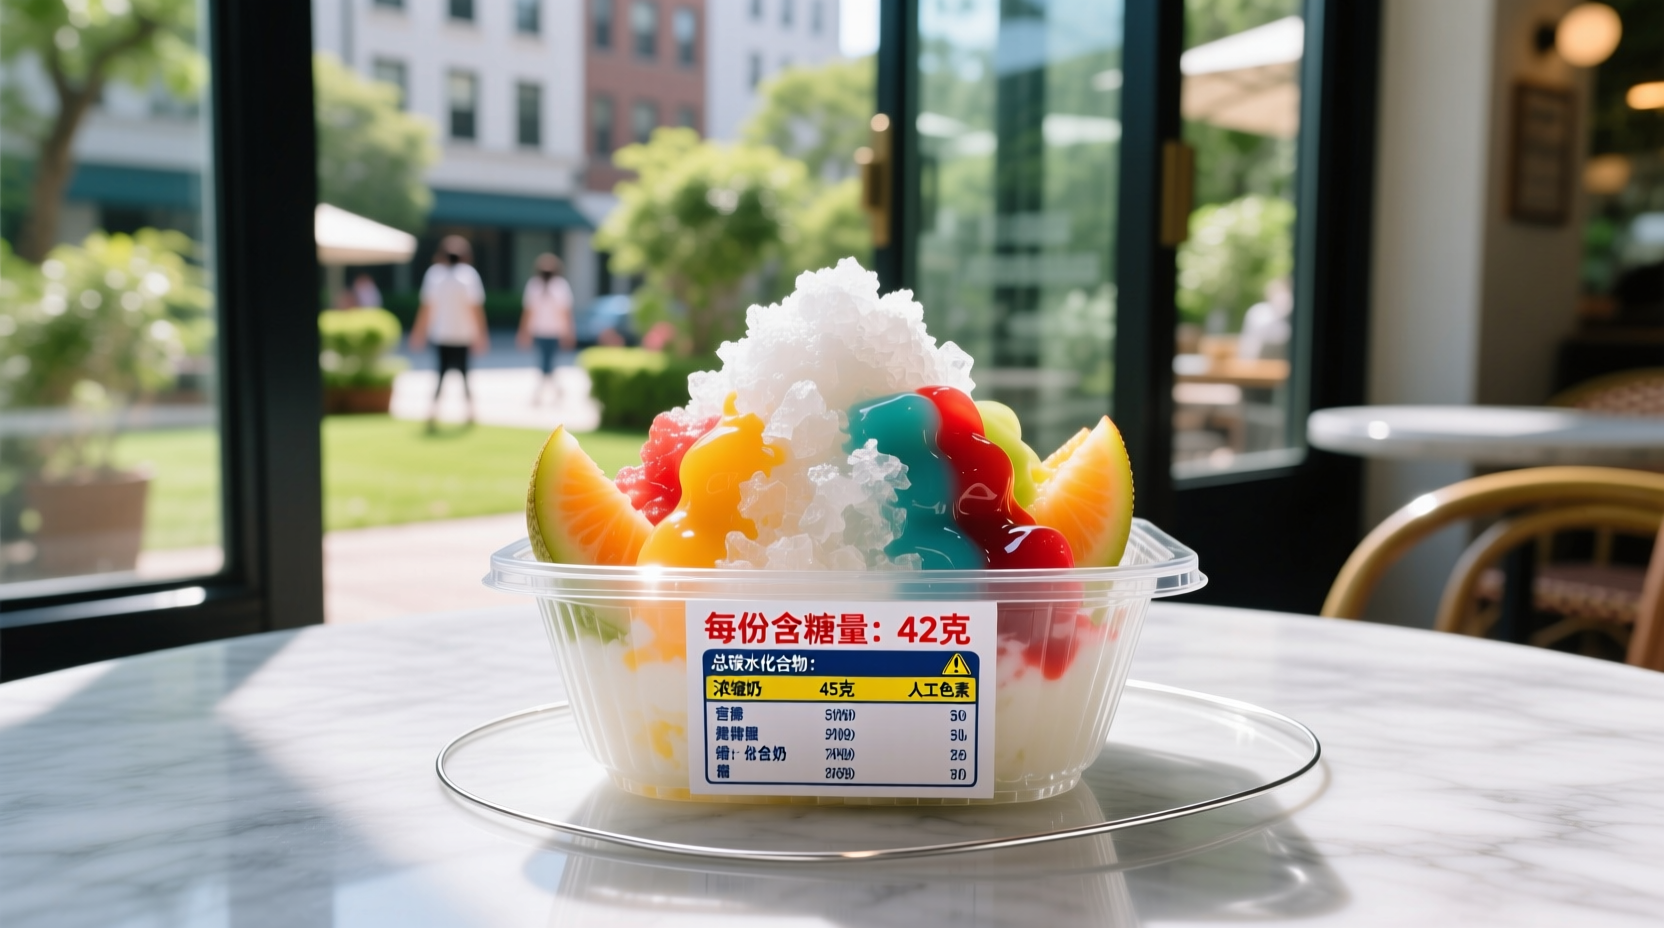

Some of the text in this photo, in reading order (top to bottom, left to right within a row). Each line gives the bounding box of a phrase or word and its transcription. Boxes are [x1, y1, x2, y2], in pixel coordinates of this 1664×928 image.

[819, 679, 855, 697] 45克
[908, 681, 970, 698] 人工色素
